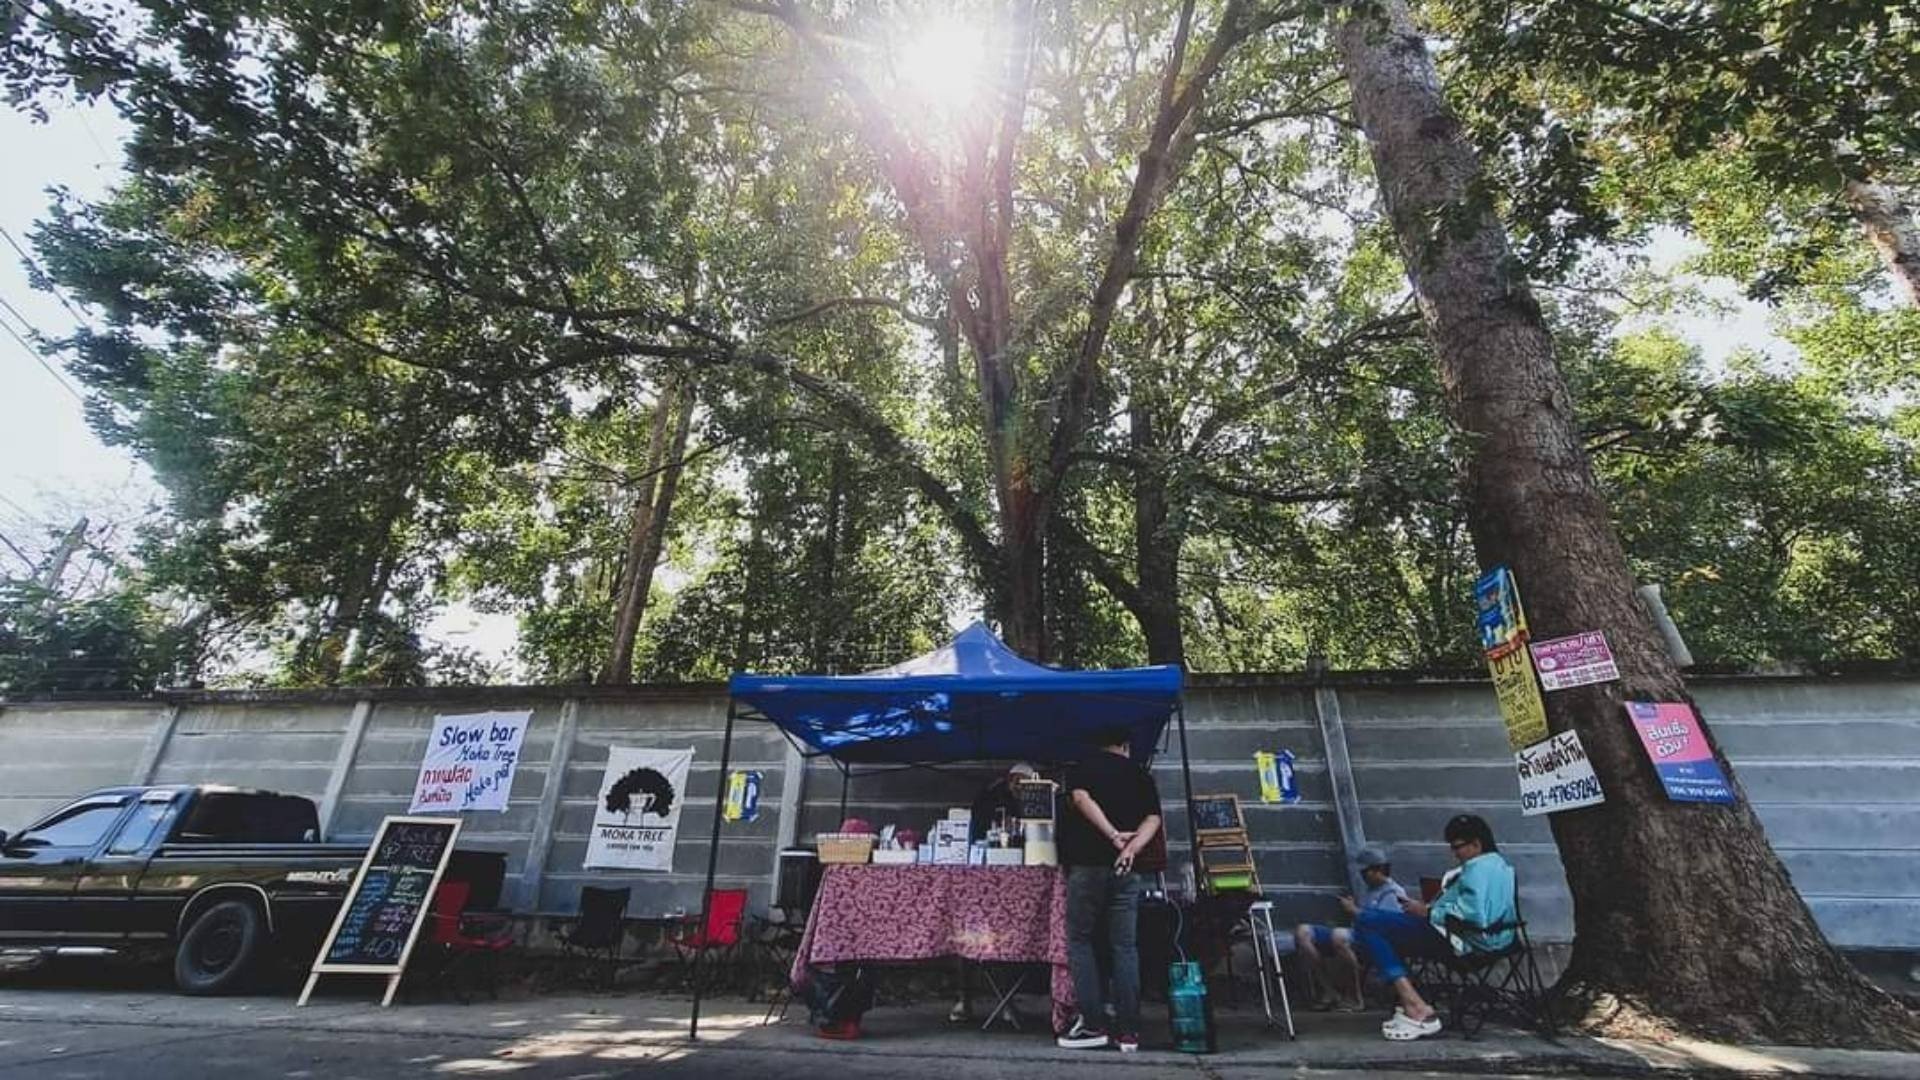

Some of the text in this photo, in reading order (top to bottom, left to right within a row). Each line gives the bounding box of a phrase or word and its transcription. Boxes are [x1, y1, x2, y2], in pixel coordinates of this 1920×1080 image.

[440, 720, 518, 747] Slow bar
[494, 743, 516, 761] Tree
[600, 828, 665, 843] MOKA TREE
